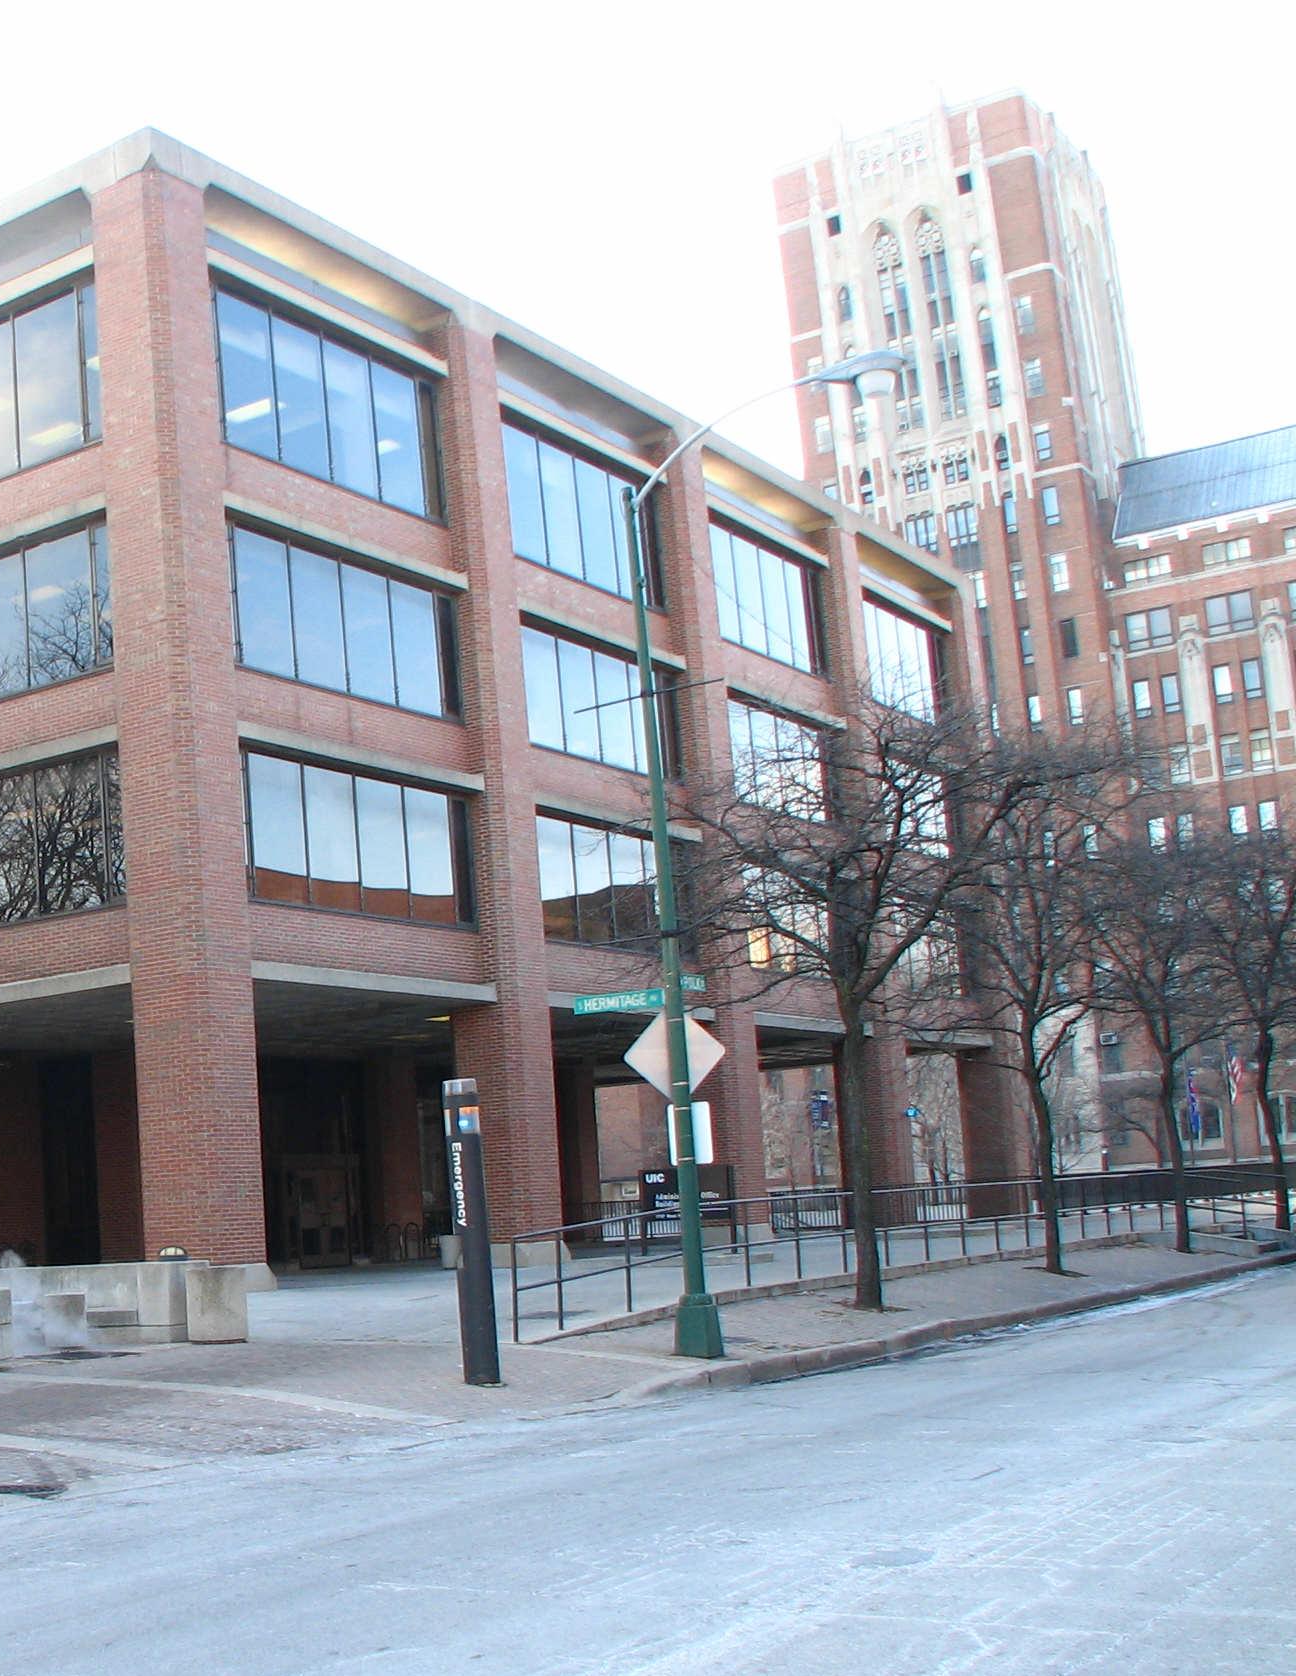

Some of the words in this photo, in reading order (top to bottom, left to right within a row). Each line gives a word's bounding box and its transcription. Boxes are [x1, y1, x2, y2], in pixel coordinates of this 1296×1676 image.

[584, 992, 647, 1012] HERMITAGE
[451, 1142, 467, 1227] Emergency
[645, 1173, 665, 1184] UIC
